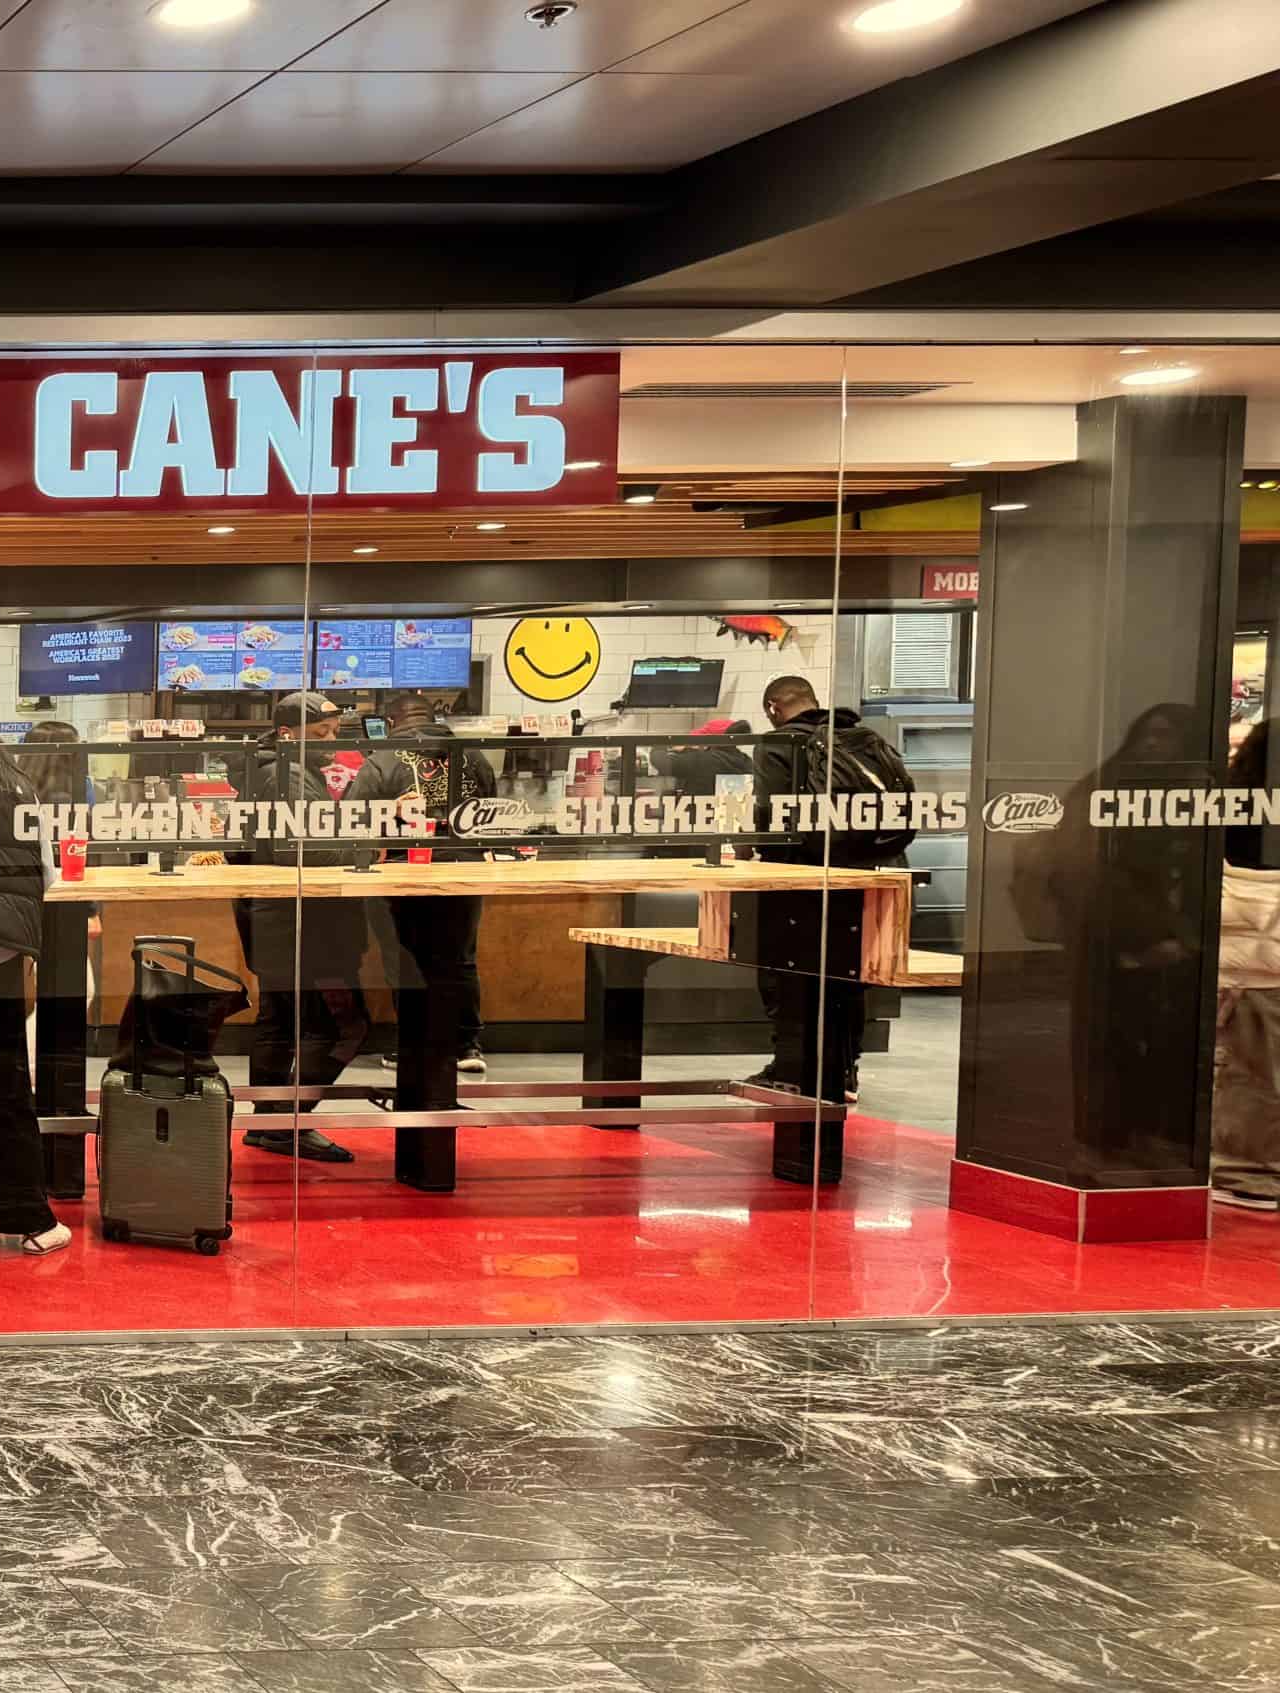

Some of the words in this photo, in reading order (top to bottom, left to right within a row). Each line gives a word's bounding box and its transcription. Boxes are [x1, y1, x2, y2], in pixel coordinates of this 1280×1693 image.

[33, 361, 566, 498] CANE'S
[13, 801, 215, 841] CHICKEN
[226, 799, 426, 839] FINGERS
[556, 795, 755, 834] CHICKEN
[769, 792, 967, 832] FINGERS
[985, 792, 1060, 829] Cane's
[1089, 788, 1280, 827] CHICKEN
